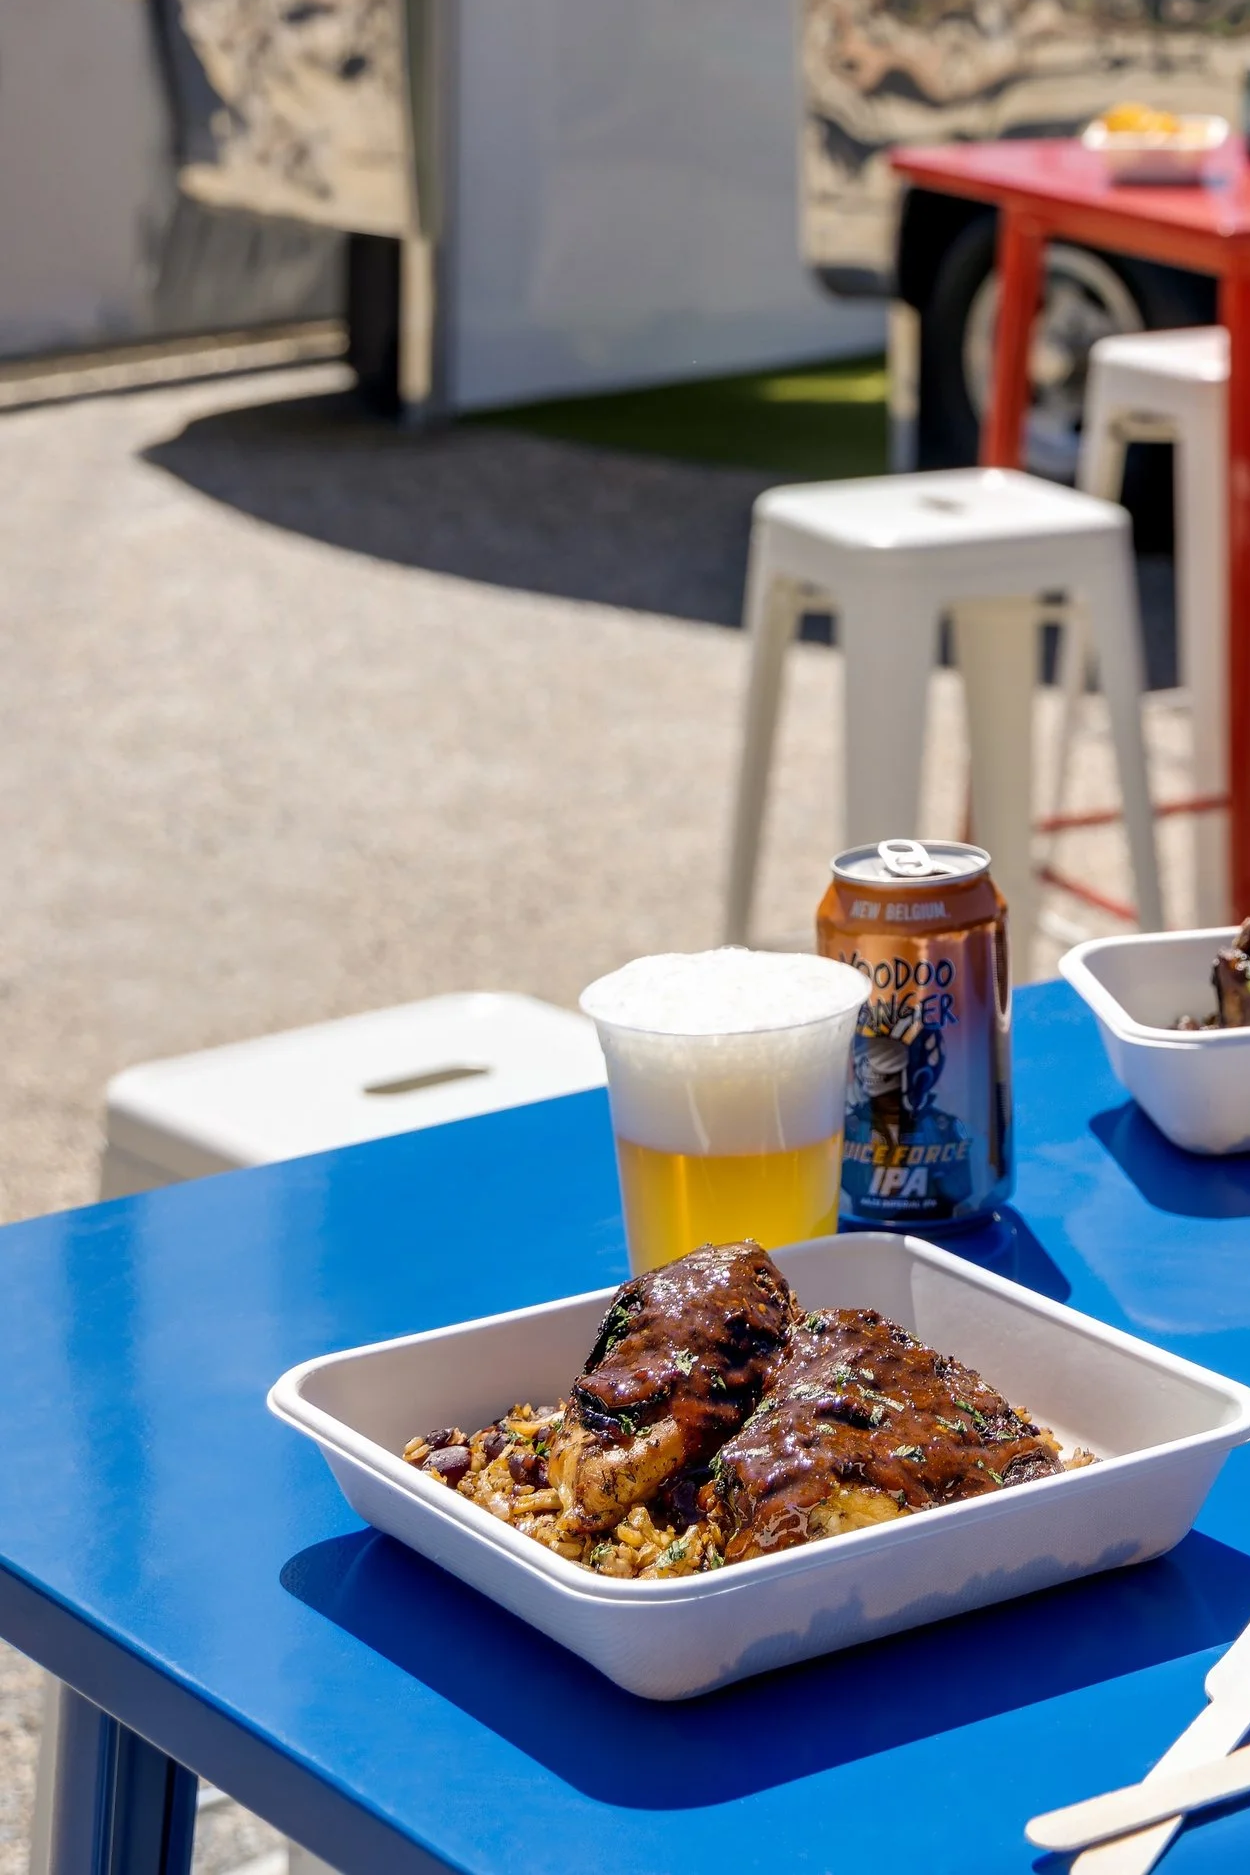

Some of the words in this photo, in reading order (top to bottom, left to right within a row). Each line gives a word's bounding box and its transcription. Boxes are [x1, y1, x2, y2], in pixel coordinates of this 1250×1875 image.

[850, 899, 881, 921] NEW
[843, 1140, 888, 1165] UICE
[891, 1140, 969, 1165] FORCE
[867, 1167, 929, 1198] IPA
